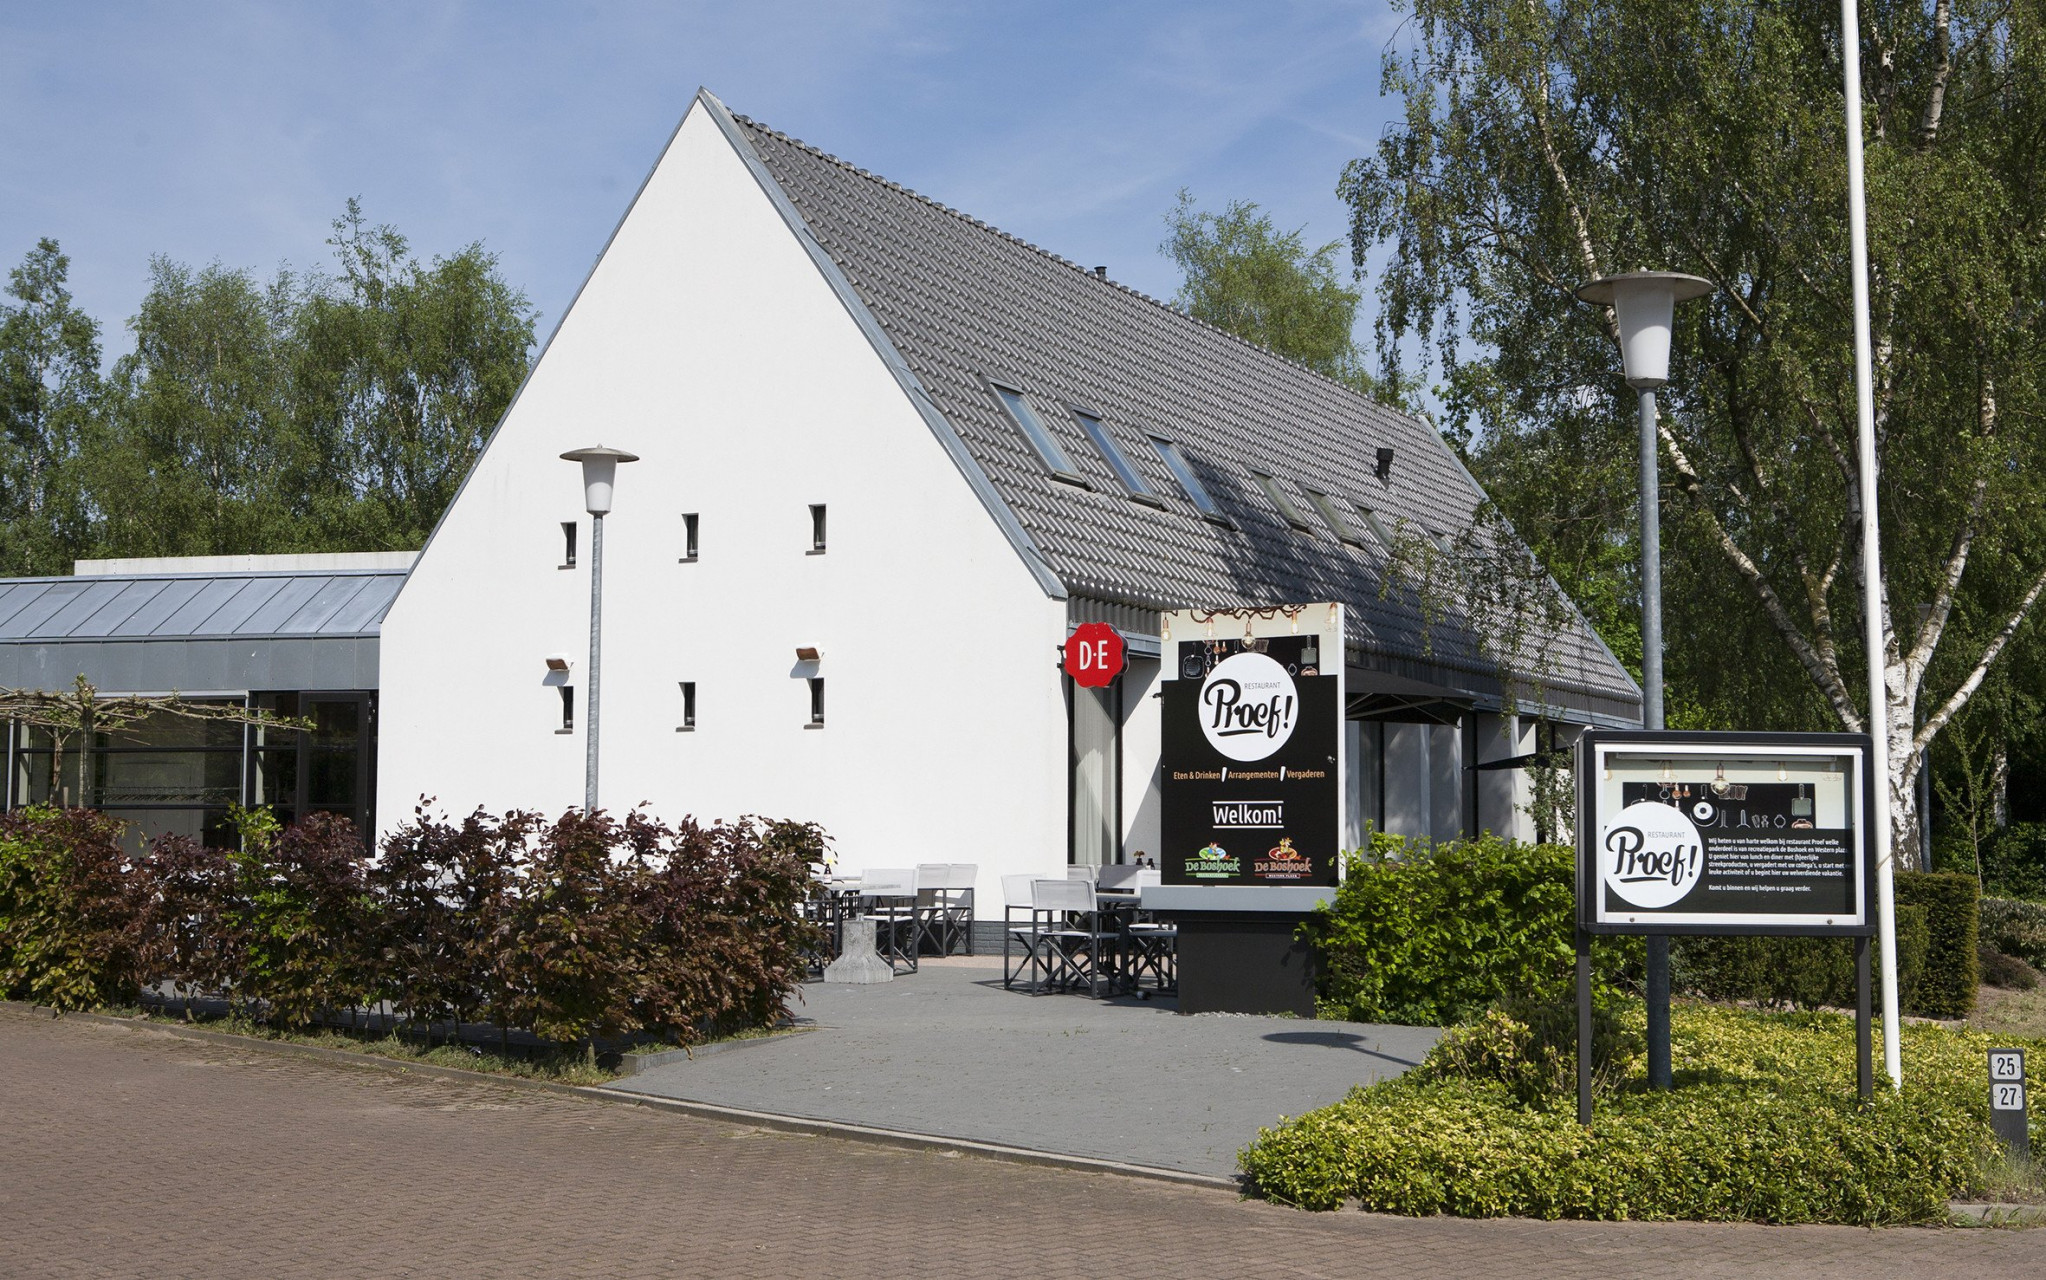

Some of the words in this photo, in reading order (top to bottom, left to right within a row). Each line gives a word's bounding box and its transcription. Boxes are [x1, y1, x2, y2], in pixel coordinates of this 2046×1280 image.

[1244, 682, 1280, 690] RESTAURANT
[1204, 678, 1293, 739] Proef!
[1173, 772, 1188, 780] Eten
[1189, 772, 1194, 780] &
[1195, 771, 1221, 779] Drinken
[1228, 771, 1279, 780] Arrangementen
[1286, 770, 1325, 779] Vergaderen
[1213, 804, 1283, 824] Welkom!
[1605, 826, 1697, 886] Proef!
[1997, 1057, 2015, 1075] 25
[2000, 1087, 2017, 1106] 27
